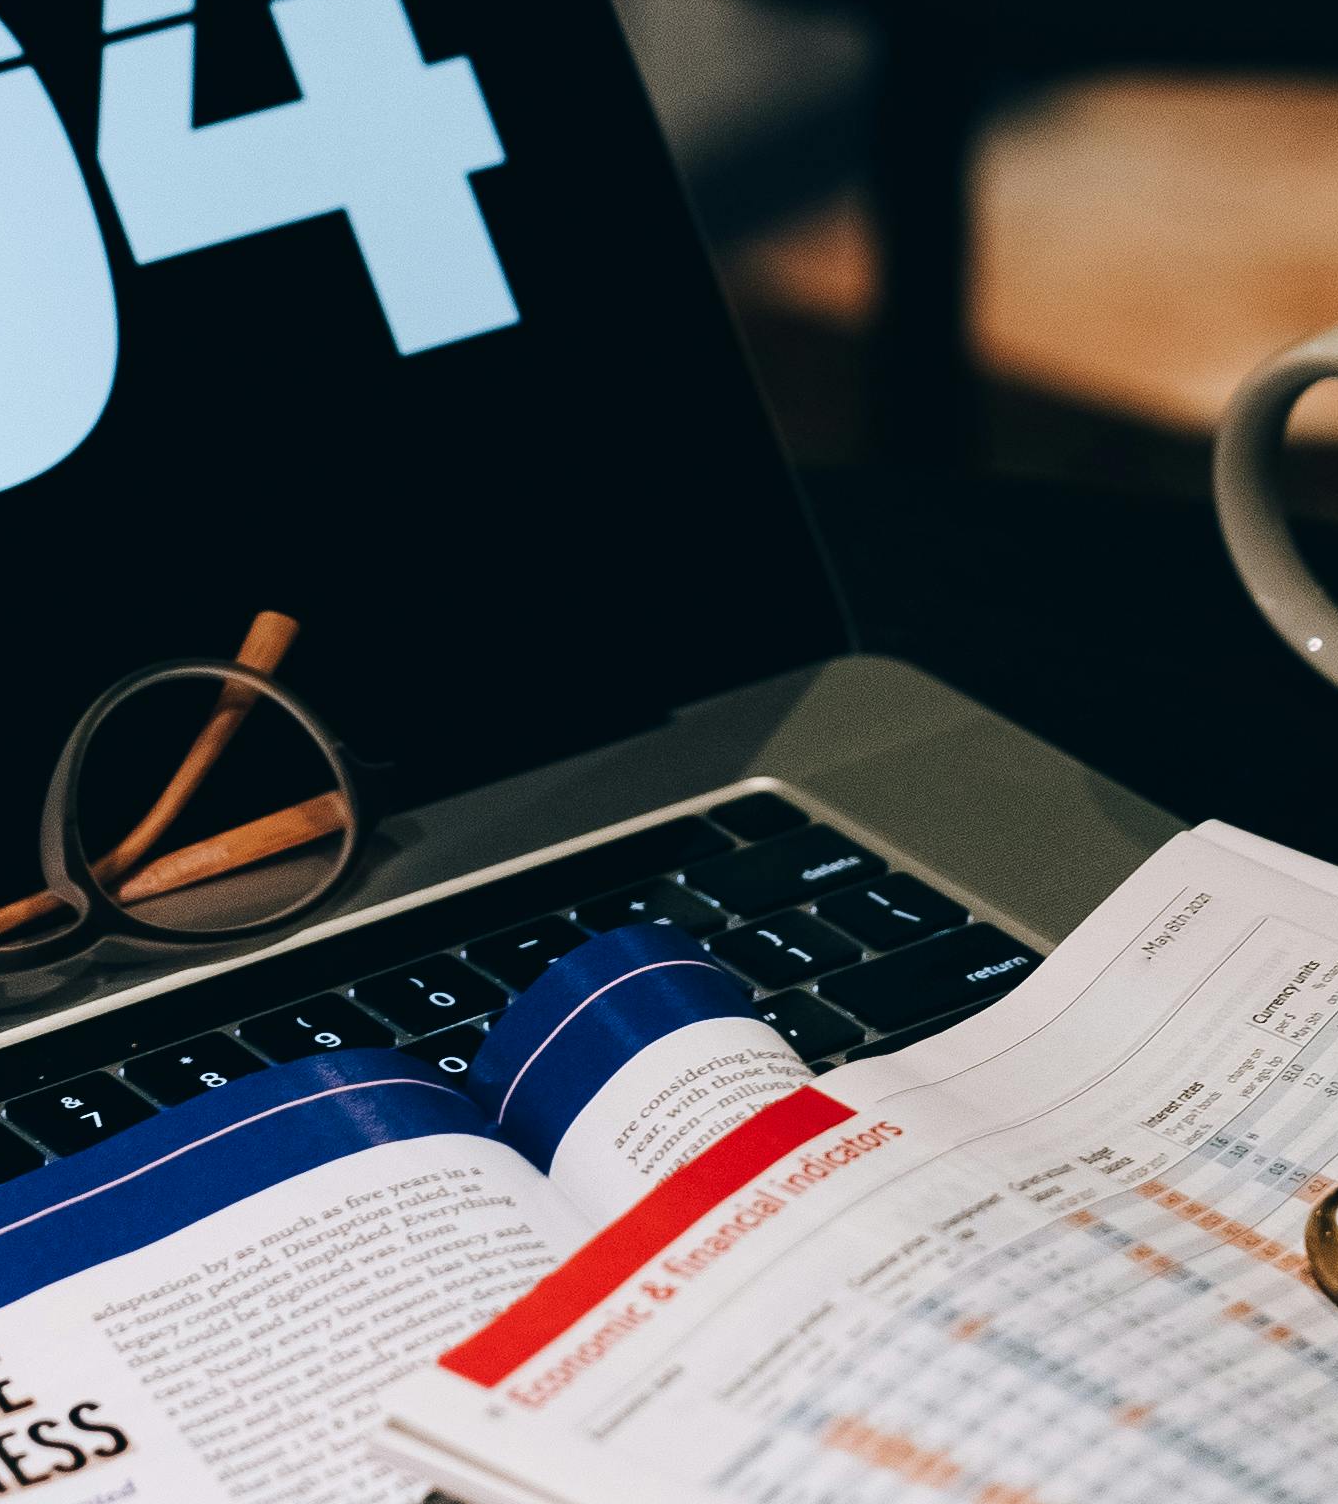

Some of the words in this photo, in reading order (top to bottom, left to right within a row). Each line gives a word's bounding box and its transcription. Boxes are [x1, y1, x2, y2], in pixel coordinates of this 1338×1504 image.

[801, 855, 862, 882] delete
[965, 953, 1030, 983] return
[1141, 930, 1173, 958] May
[427, 990, 457, 1009] 0
[1252, 982, 1302, 1024] Currency
[1292, 959, 1321, 985] units
[313, 1030, 343, 1050] 9
[59, 1094, 83, 1110] &
[197, 1071, 229, 1089] 8
[614, 1119, 640, 1151] are
[640, 1050, 747, 1120] considering
[79, 1111, 105, 1130] 7
[626, 1124, 667, 1167] year,
[666, 1085, 710, 1120] with
[711, 1064, 765, 1091] those
[1141, 1100, 1183, 1129] Interest
[1177, 1081, 1205, 1104] rates
[92, 1272, 202, 1322] adaptation
[201, 1256, 230, 1277] by
[234, 1245, 257, 1261] as
[260, 1215, 318, 1249] much
[321, 1205, 344, 1221] as
[345, 1187, 386, 1211] five
[387, 1172, 443, 1197] years
[444, 1165, 467, 1180] in
[206, 1254, 279, 1299] period.
[281, 1205, 393, 1259] Disruption
[396, 1184, 459, 1212] ruled,
[460, 1182, 484, 1195] as
[464, 1239, 546, 1265] become
[505, 1296, 654, 1413] Economic
[638, 1263, 679, 1307] &
[664, 1181, 786, 1282] financial
[780, 1113, 905, 1197] indicators
[113, 1322, 180, 1355] legacy
[183, 1270, 293, 1327] companies
[295, 1221, 398, 1274] imploded.
[401, 1194, 517, 1229] Everything
[127, 1346, 170, 1370] that
[173, 1318, 232, 1352] could
[233, 1306, 261, 1324] be
[405, 1221, 458, 1245] from
[140, 1337, 244, 1385] education
[373, 1264, 398, 1279] to
[401, 1231, 490, 1269] currency
[495, 1222, 534, 1240] and
